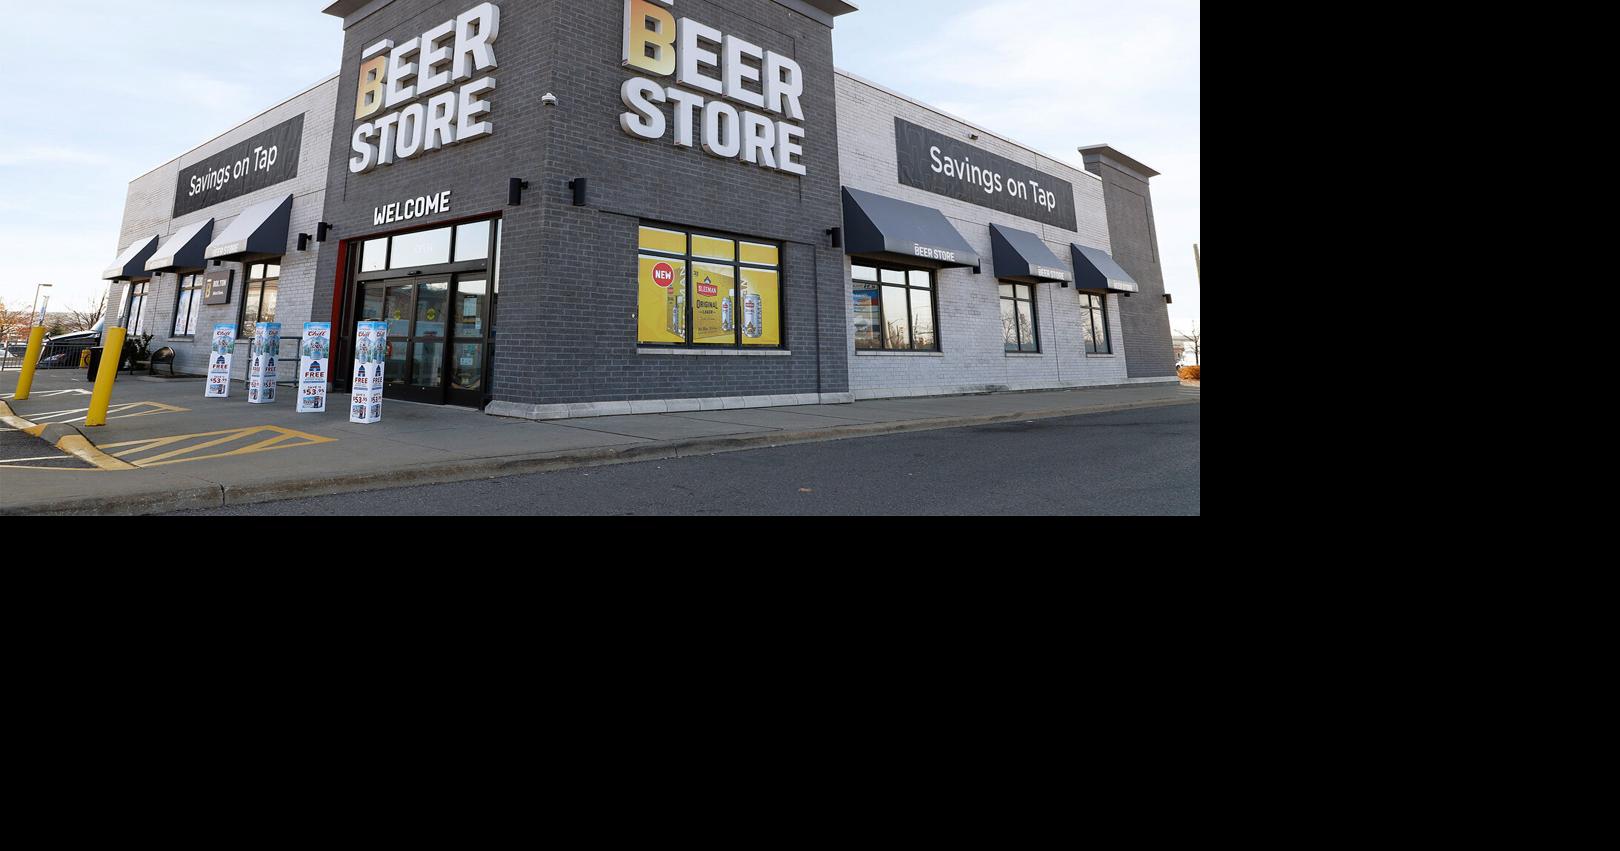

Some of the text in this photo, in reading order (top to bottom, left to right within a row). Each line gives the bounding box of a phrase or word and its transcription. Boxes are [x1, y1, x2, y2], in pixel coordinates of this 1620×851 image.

[355, 2, 500, 120] BEER
[622, 0, 805, 121] BEER
[349, 76, 496, 173] STORE
[620, 77, 807, 176] STORE
[188, 145, 278, 197] Savings on Tap
[929, 145, 1056, 212] Savings on Tap
[373, 190, 452, 226] WELCOME
[655, 271, 672, 281] NEW
[913, 243, 956, 262] BEER STORE
[696, 299, 718, 310] ORIGINAL
[698, 284, 718, 295] SLEEMAN
